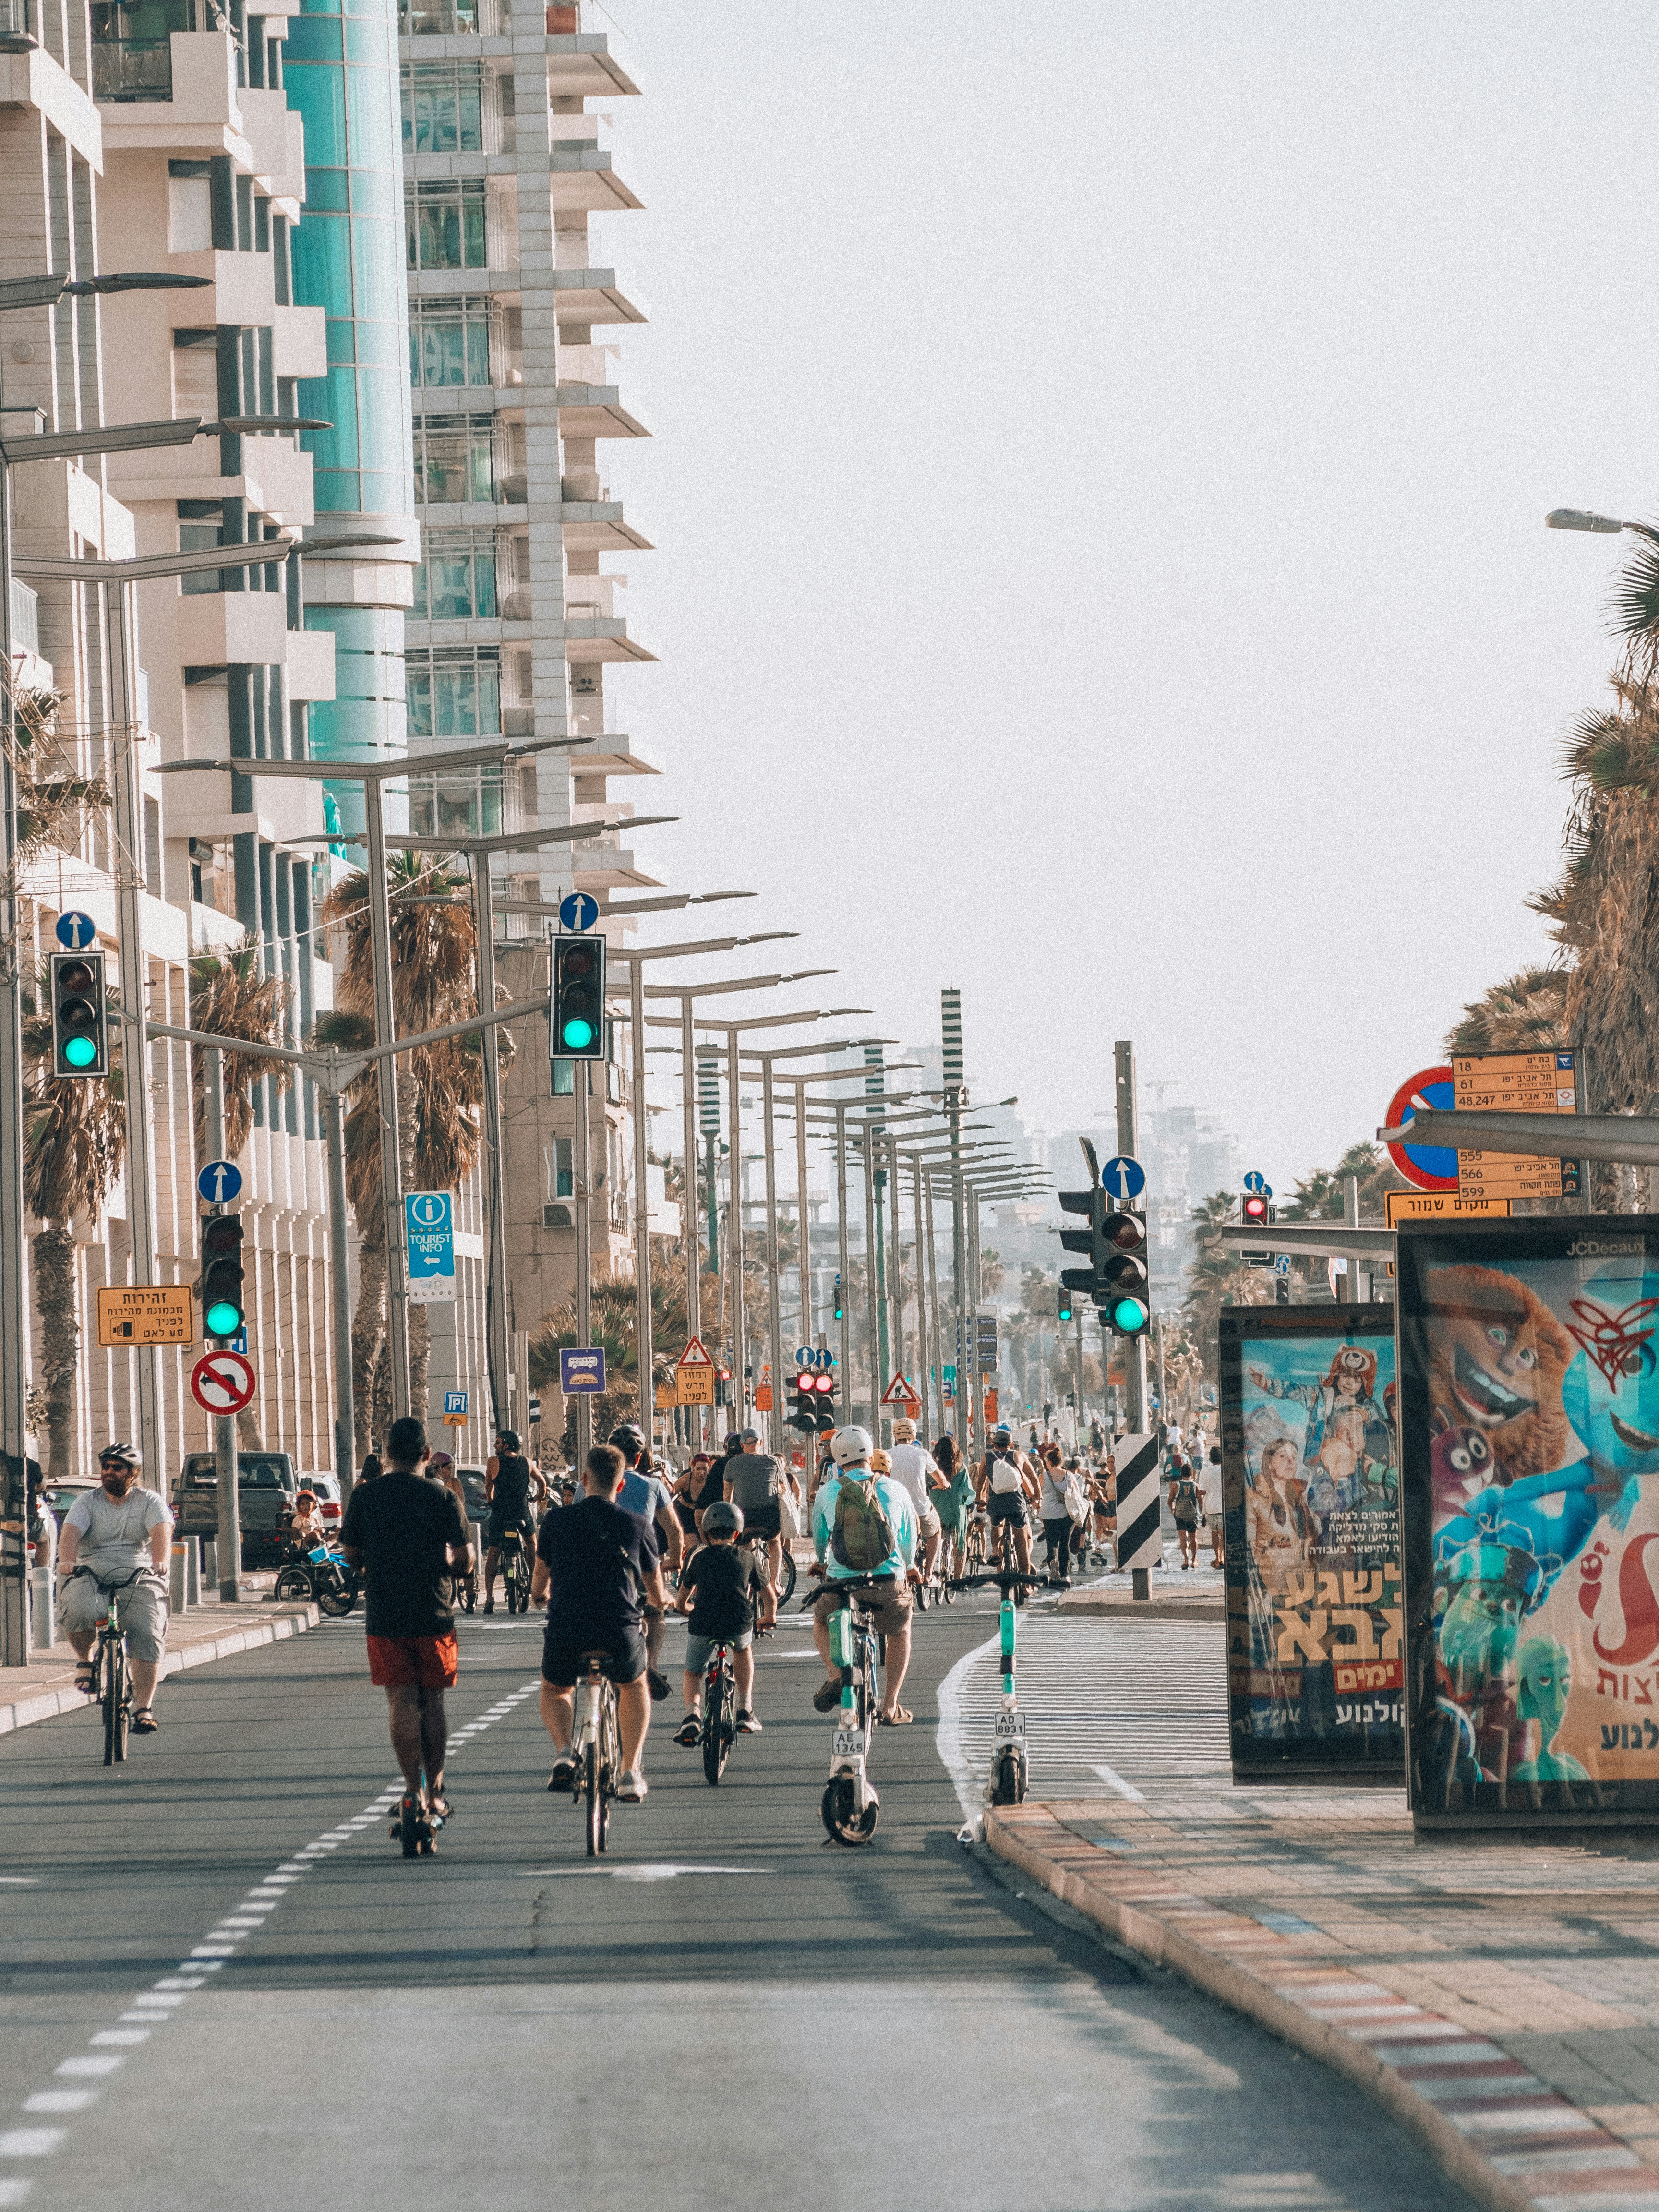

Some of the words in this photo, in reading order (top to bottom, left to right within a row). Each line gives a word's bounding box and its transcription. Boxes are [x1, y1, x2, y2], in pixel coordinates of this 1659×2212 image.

[1459, 1062, 1472, 1071] 18
[1460, 1080, 1472, 1089] 61
[1459, 1095, 1495, 1108] 48,247
[1460, 1151, 1482, 1162] 555
[1461, 1169, 1483, 1179] 566
[1462, 1187, 1484, 1198] 599
[1408, 1200, 1444, 1211] שמור
[1454, 1200, 1489, 1211] מקום
[409, 1233, 451, 1244] TOURIST
[420, 1243, 442, 1252] INFO
[1566, 1241, 1646, 1256] JCDecaux
[123, 1293, 166, 1304] זהירות
[108, 1308, 141, 1316] מהירות
[156, 1317, 183, 1327] לפניך
[144, 1329, 164, 1337] לאט
[169, 1329, 183, 1337] סע
[684, 1392, 707, 1401] לפניך
[1330, 1510, 1358, 1521] לצאת
[1361, 1511, 1396, 1520] אמורים
[1329, 1521, 1367, 1533] מדליקה
[1370, 1522, 1388, 1533] סקי
[1336, 1532, 1365, 1543] לאמא
[1368, 1534, 1399, 1542] הודיעו
[1309, 1545, 1347, 1555] בעבודה
[1350, 1543, 1390, 1554] להישאר
[1337, 1664, 1394, 1690] ימים
[1001, 1716, 1014, 1724] AD
[838, 1733, 853, 1742] AE
[836, 1743, 863, 1753] 1345
